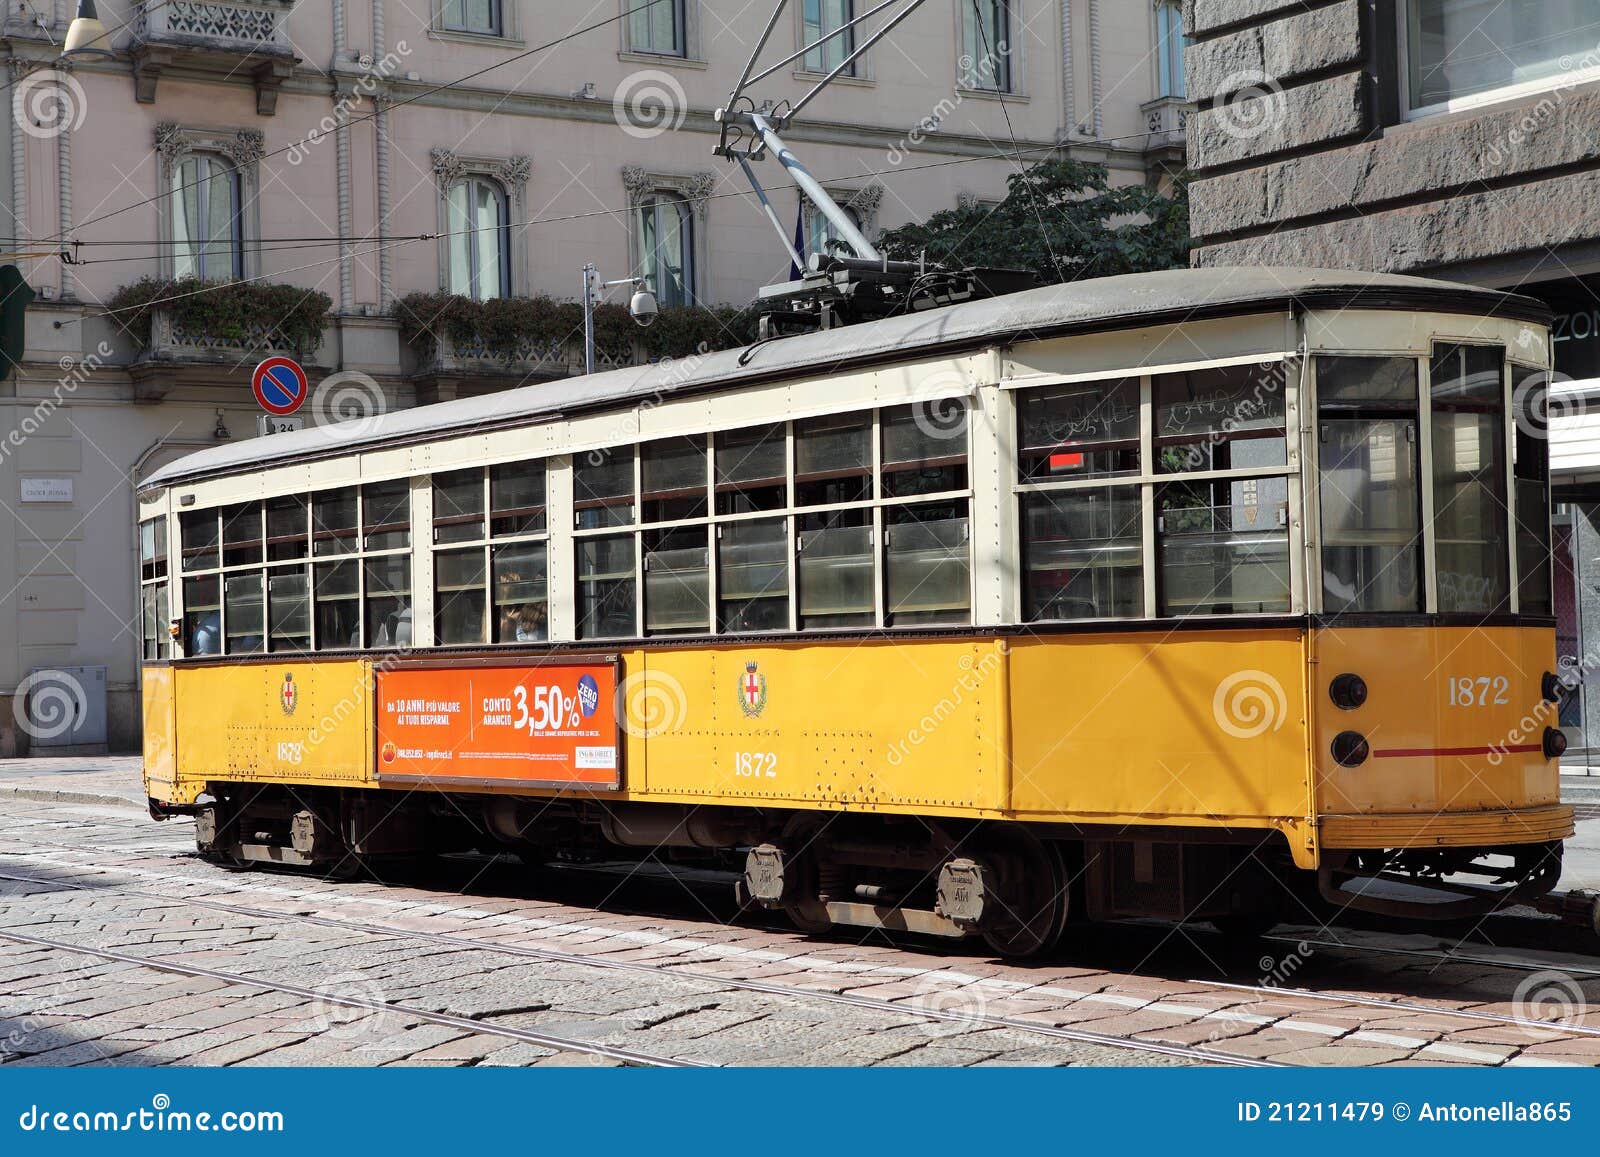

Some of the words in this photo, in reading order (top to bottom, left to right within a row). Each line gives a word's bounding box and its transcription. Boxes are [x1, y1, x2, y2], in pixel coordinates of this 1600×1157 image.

[579, 682, 598, 703] ZERO
[1448, 675, 1510, 707] 1872
[387, 702, 395, 713] DA
[396, 699, 405, 713] 10
[406, 699, 425, 713] ANNI
[437, 702, 461, 713] VALORE
[483, 697, 512, 712] CONTO
[513, 685, 580, 737] 3,50%
[397, 714, 404, 726] AI
[405, 714, 419, 726] TUOI
[483, 713, 512, 727] ARANCIO
[735, 751, 777, 777] 1872
